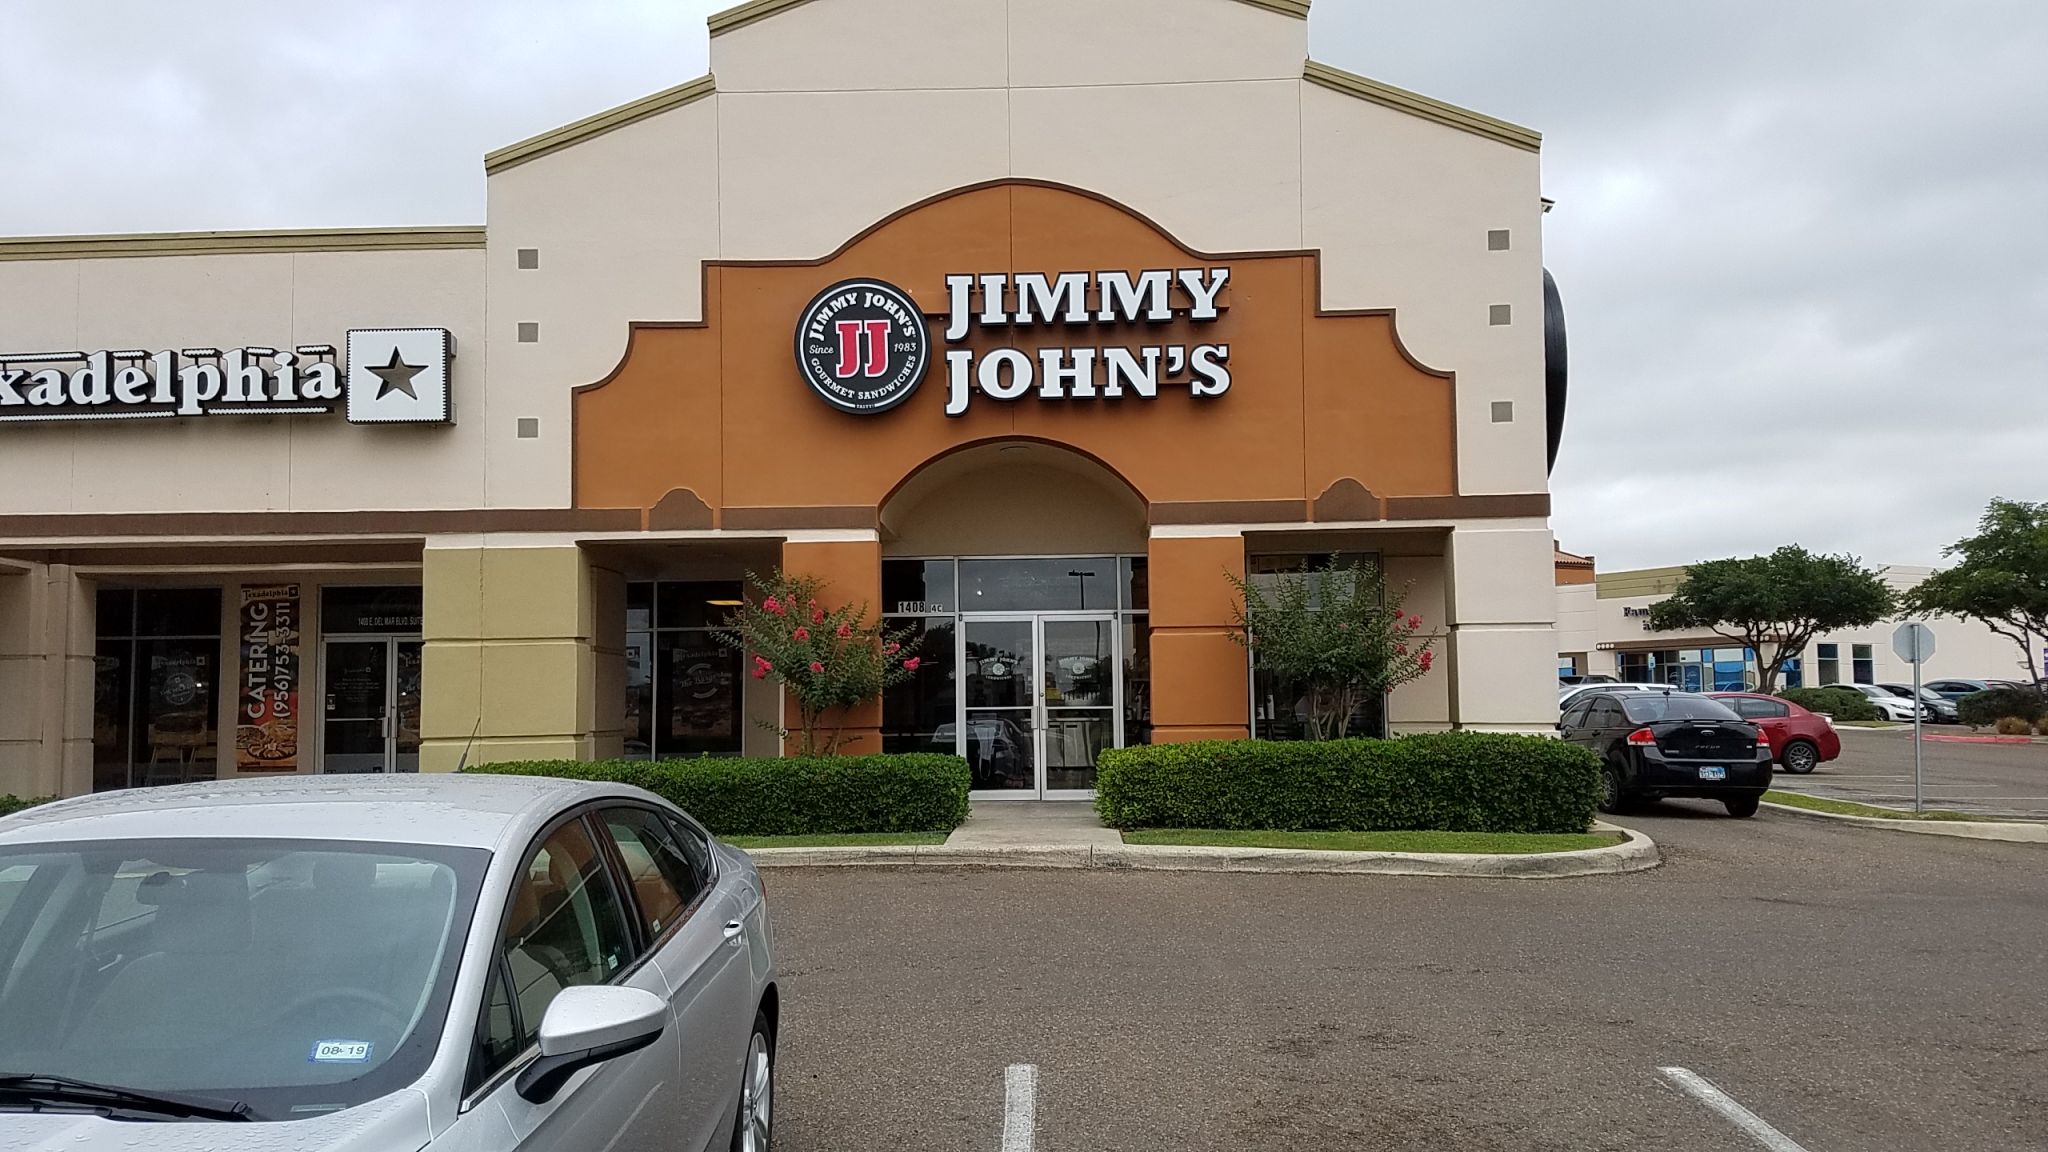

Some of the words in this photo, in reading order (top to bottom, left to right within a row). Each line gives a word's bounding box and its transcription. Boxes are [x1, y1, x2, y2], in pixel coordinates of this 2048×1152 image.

[809, 293, 858, 341] JIMMY
[864, 292, 916, 338] JOHN'S
[945, 268, 1230, 342] JIMMY
[809, 344, 834, 354] Since
[835, 319, 891, 378] JJ
[894, 342, 917, 353] 1983
[811, 357, 855, 399] GOURMET
[858, 355, 916, 400] SANDWICHES
[945, 344, 1231, 417] JOHN'S
[899, 602, 925, 613] 1408
[931, 604, 942, 612] 4C
[247, 602, 269, 719] CATERING
[273, 602, 291, 718] (956)753-3311
[321, 1046, 339, 1055] 08
[348, 1046, 365, 1055] 19
